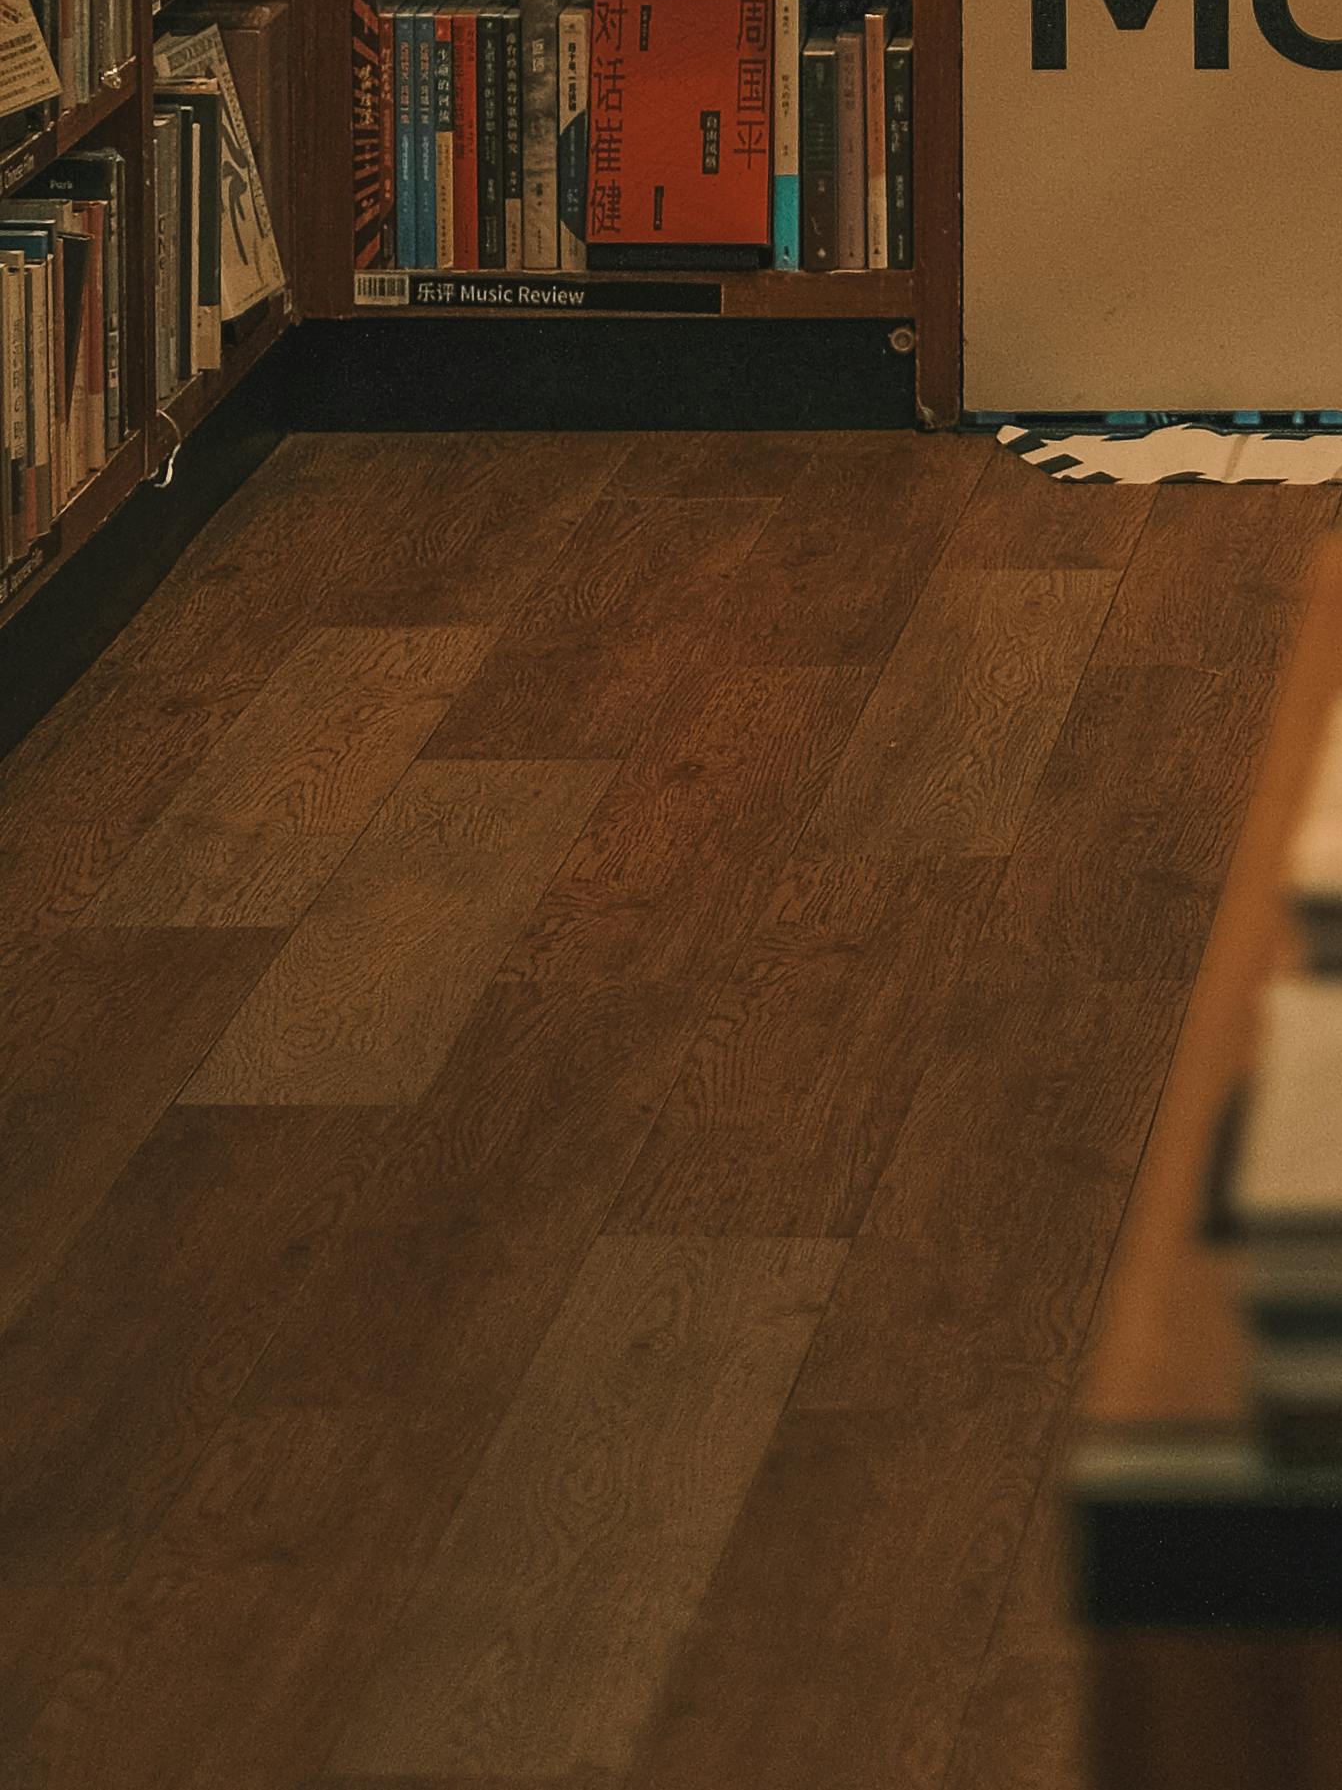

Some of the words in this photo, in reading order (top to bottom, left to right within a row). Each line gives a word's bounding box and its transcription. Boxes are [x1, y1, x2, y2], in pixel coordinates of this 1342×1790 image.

[417, 285, 455, 304] 乐评
[460, 285, 514, 305] Music
[519, 285, 584, 305] Review
